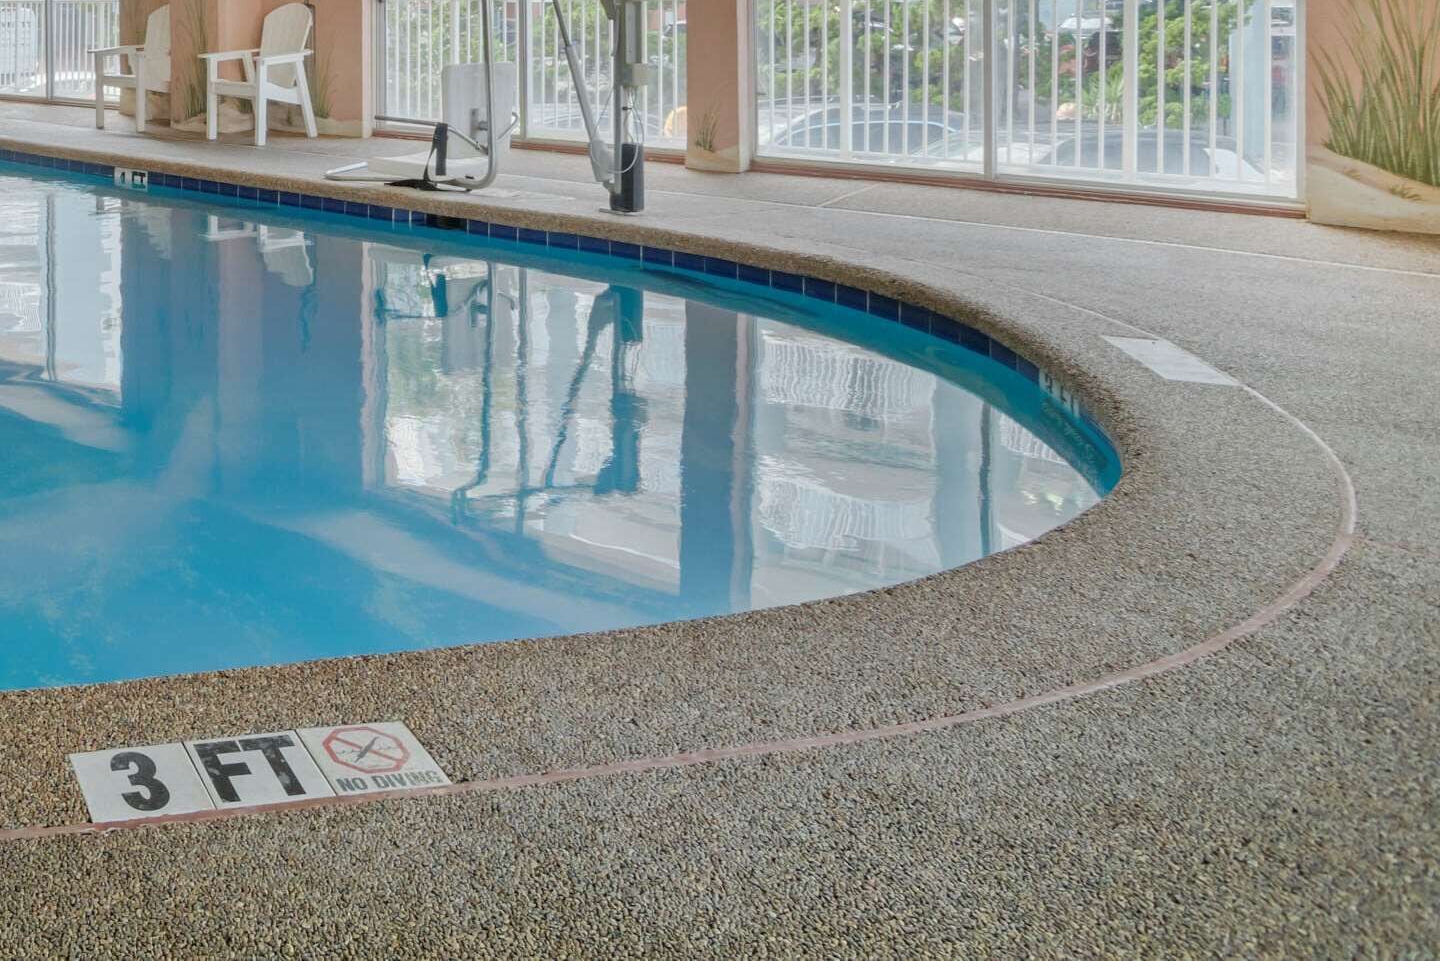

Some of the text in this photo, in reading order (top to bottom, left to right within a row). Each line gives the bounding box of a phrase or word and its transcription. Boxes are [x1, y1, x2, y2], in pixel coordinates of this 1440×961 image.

[109, 734, 308, 812] 3 FT
[335, 769, 445, 793] NO DIVING
